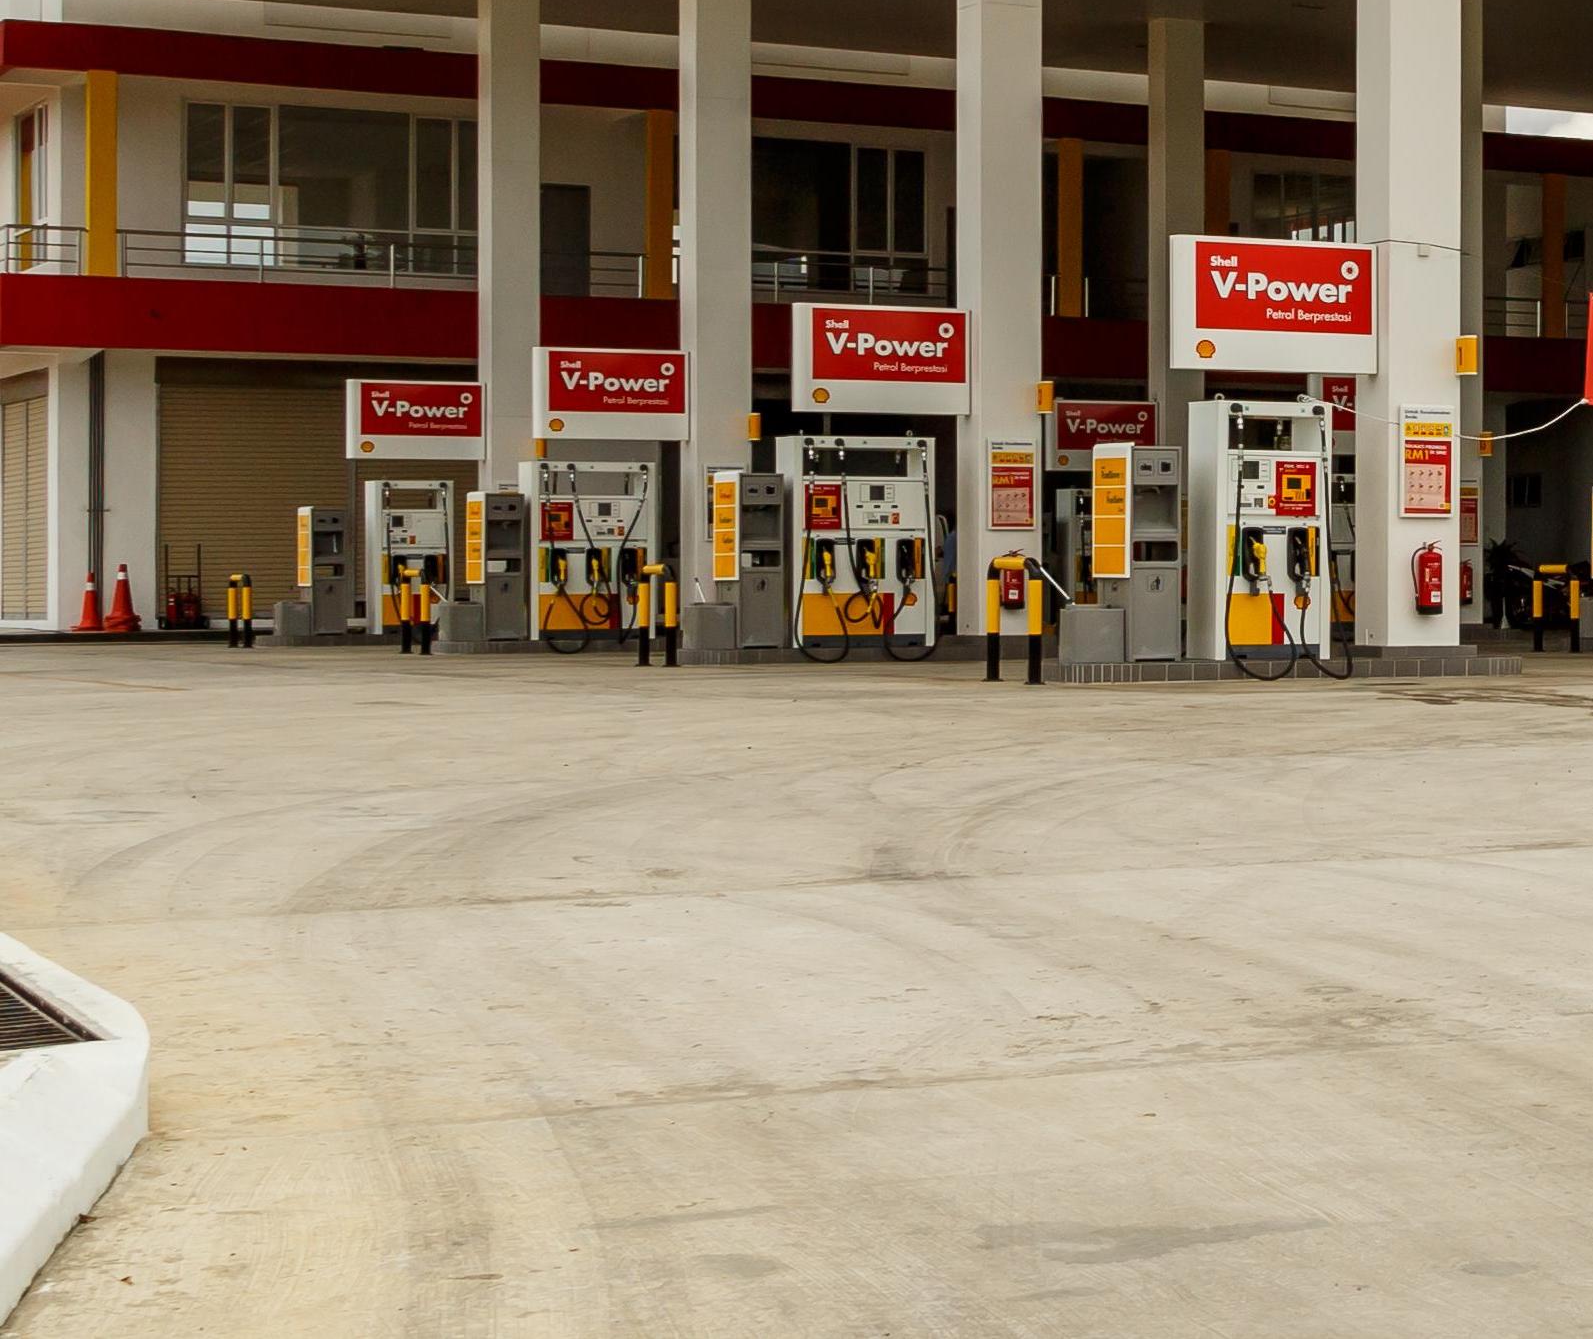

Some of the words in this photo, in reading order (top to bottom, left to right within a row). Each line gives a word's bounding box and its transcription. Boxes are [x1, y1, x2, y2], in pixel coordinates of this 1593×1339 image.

[1210, 256, 1238, 267] Shell
[1210, 271, 1352, 304] V-Power
[825, 319, 849, 329] Shell
[1266, 308, 1295, 320] Petrol
[1297, 309, 1352, 324] Berprestasi
[825, 332, 948, 358] V-Power
[560, 360, 581, 369] Shell
[873, 362, 898, 371] Petrol
[901, 362, 948, 374] Berprestasi
[560, 371, 669, 393] V-Power
[371, 400, 468, 419] V-Power
[1066, 418, 1145, 435] V-Power
